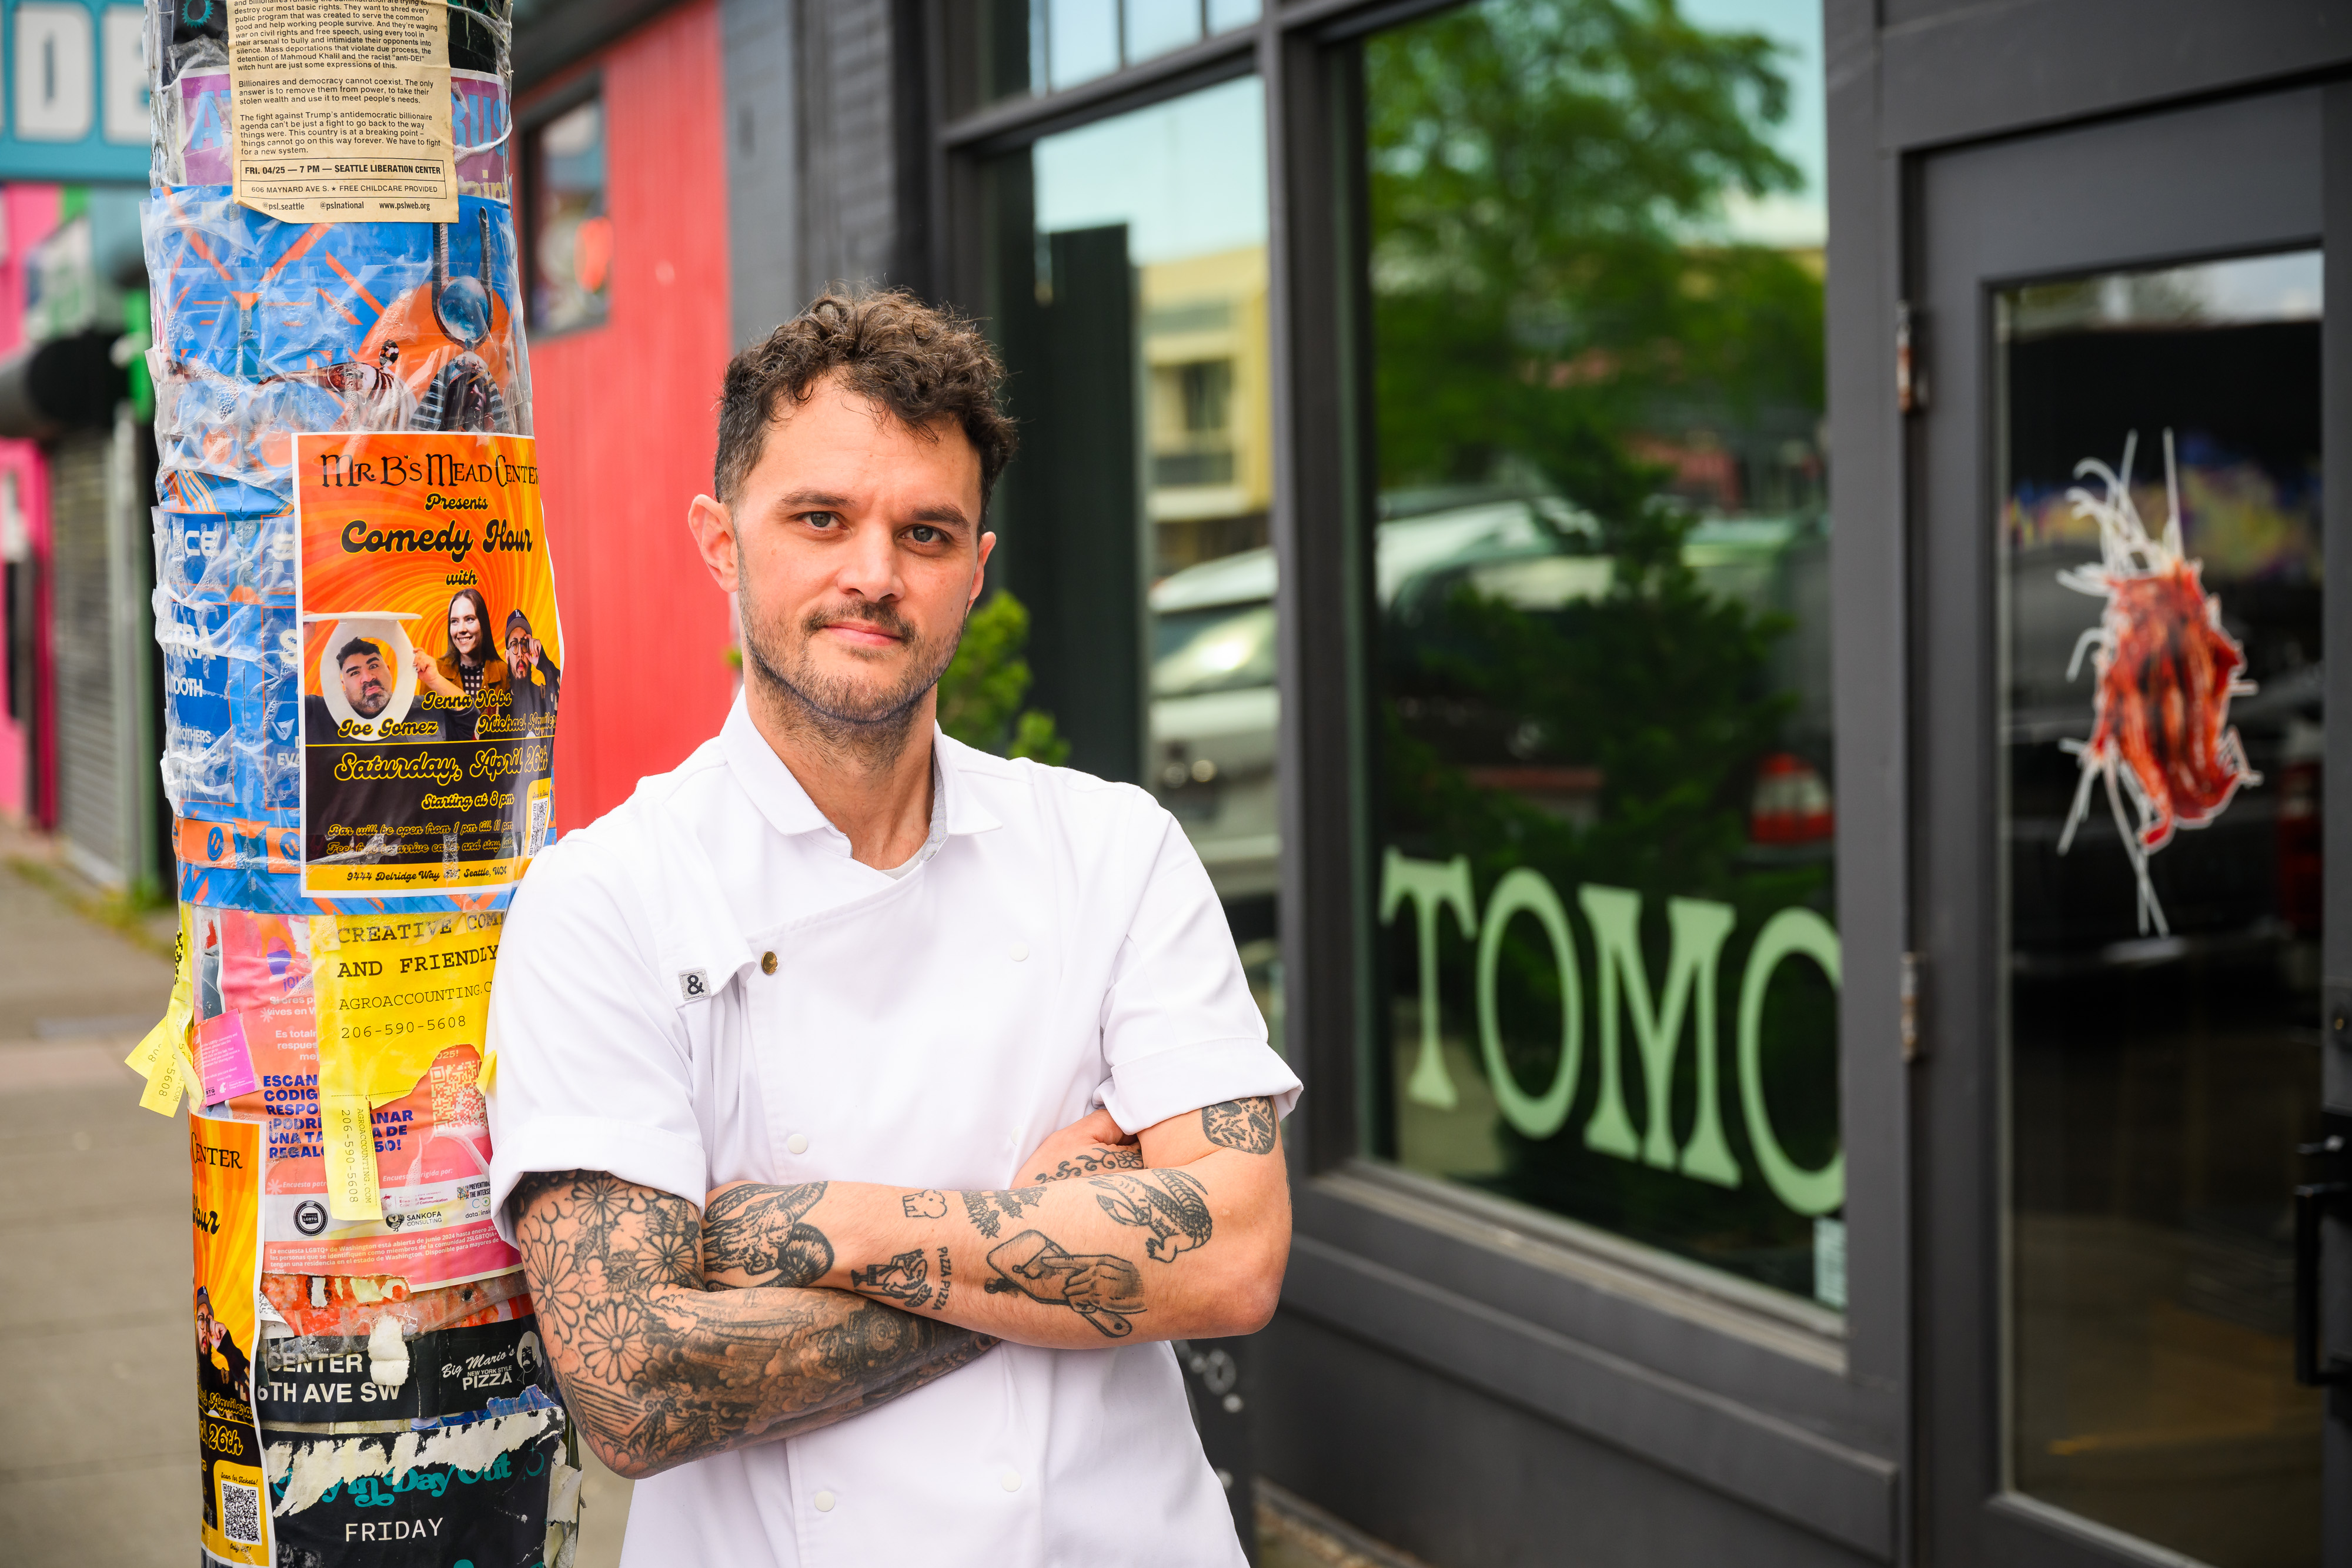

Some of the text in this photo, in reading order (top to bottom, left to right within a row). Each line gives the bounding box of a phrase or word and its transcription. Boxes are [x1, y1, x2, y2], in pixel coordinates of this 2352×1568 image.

[256, 113, 273, 122] fight
[275, 112, 303, 121] against
[335, 165, 368, 173] SEATTLE
[370, 165, 413, 173] LIBERATION
[415, 166, 440, 174] CENTER
[262, 202, 305, 210] @psl.seattle
[320, 201, 363, 210] @pslnational
[379, 201, 430, 211] www.pslweb.org
[425, 493, 489, 511] Presents
[341, 519, 533, 563] Comedy Hour
[445, 569, 479, 586] with
[422, 689, 512, 710] Jenna Nobs
[338, 717, 439, 739] Joe Gomez
[476, 713, 526, 734] Michael
[335, 745, 548, 786] Saturday, April 26th
[421, 794, 473, 811] Starting
[475, 793, 488, 807] at
[490, 791, 498, 806] 8
[499, 794, 514, 808] pm
[328, 824, 353, 836] Bar
[356, 824, 378, 835] will
[380, 824, 394, 835] be
[396, 826, 423, 838] open
[425, 822, 451, 835] from
[453, 821, 460, 833] 1
[460, 823, 477, 836] pm
[479, 820, 492, 833] till
[502, 821, 513, 833] pm
[397, 842, 430, 854] arrive
[462, 839, 481, 851] and
[483, 840, 501, 852] stay
[347, 872, 372, 881] 9444
[375, 871, 417, 882] Delridge
[418, 870, 440, 881] Way
[464, 868, 491, 878] Seattle,
[493, 866, 507, 875] WA
[338, 919, 452, 944] CREATIVE
[337, 944, 499, 978] AND FRIENDLY
[687, 975, 704, 995] &
[275, 1030, 288, 1038] Es
[341, 1015, 466, 1039] 206-590-5608
[263, 1074, 318, 1087] ESCAN
[264, 1088, 320, 1102] CÓDIG
[265, 1104, 320, 1115] RESPO
[269, 1132, 301, 1144] UNA
[386, 1125, 407, 1137] DE
[341, 1109, 359, 1203] 206-590-5608
[357, 1108, 372, 1203] AGROACCOUNTING.COM
[406, 1211, 442, 1221] SANKOFA
[407, 1218, 442, 1227] CONSULTING
[339, 1243, 377, 1252] Washington
[425, 1235, 441, 1245] junio
[932, 1246, 951, 1310] PIZZA PIZZA
[268, 1352, 363, 1373] CENTER
[442, 1345, 515, 1378] Big Mario's
[462, 1372, 513, 1390] PIZZA
[303, 1383, 352, 1403] AVE
[360, 1382, 400, 1402] SW
[208, 1393, 253, 1419] Aguilera
[208, 1424, 243, 1456] 26th
[238, 1476, 258, 1486] Tickets!
[345, 1517, 443, 1542] FRIDAY
